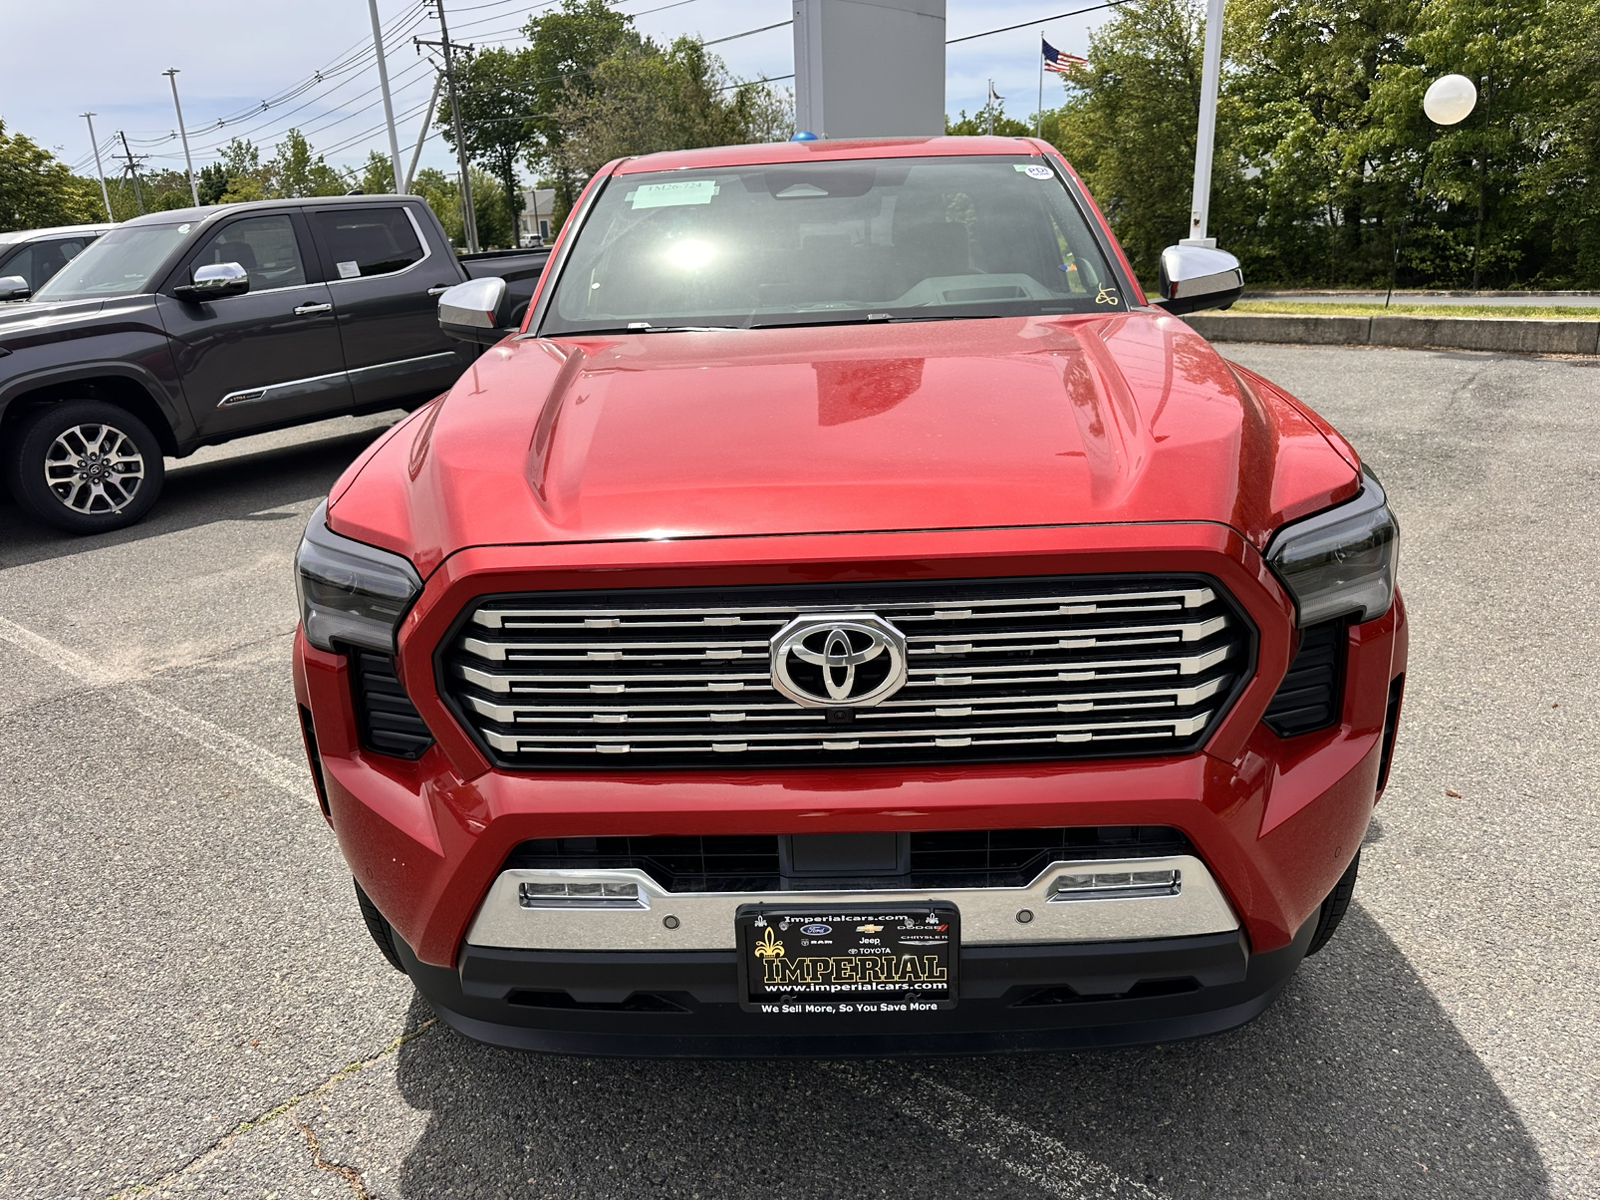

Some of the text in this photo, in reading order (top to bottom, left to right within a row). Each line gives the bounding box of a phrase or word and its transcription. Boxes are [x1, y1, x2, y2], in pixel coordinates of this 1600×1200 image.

[784, 915, 908, 924] Imperialcars.com
[859, 937, 881, 945] Jeep
[763, 955, 947, 983] IMPERIAL
[764, 982, 947, 993] www.imperialcars.com
[761, 1002, 938, 1014] We Sell More, So You Save More
